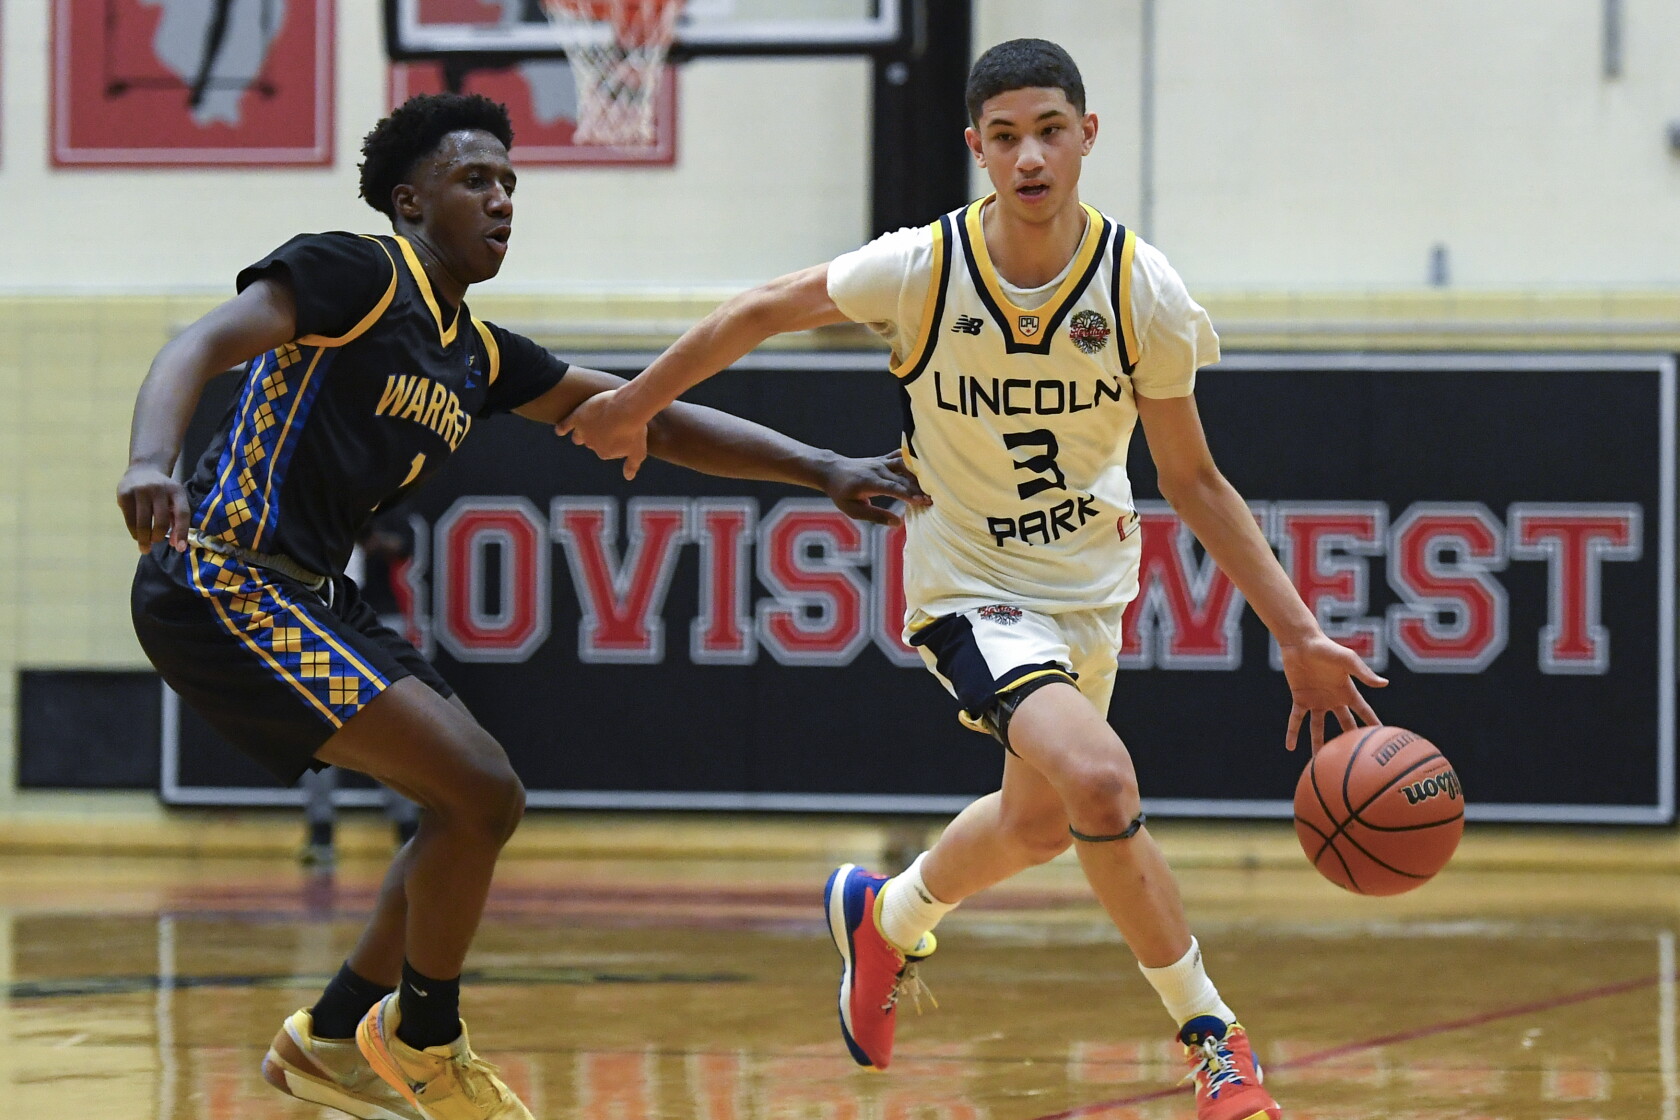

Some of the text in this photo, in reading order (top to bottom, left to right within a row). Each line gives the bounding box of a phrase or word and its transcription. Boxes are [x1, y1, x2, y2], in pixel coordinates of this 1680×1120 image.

[1020, 317, 1037, 328] CPL
[934, 371, 1121, 418] LINCOLN
[1003, 429, 1067, 500] 3
[987, 494, 1100, 547] PARK
